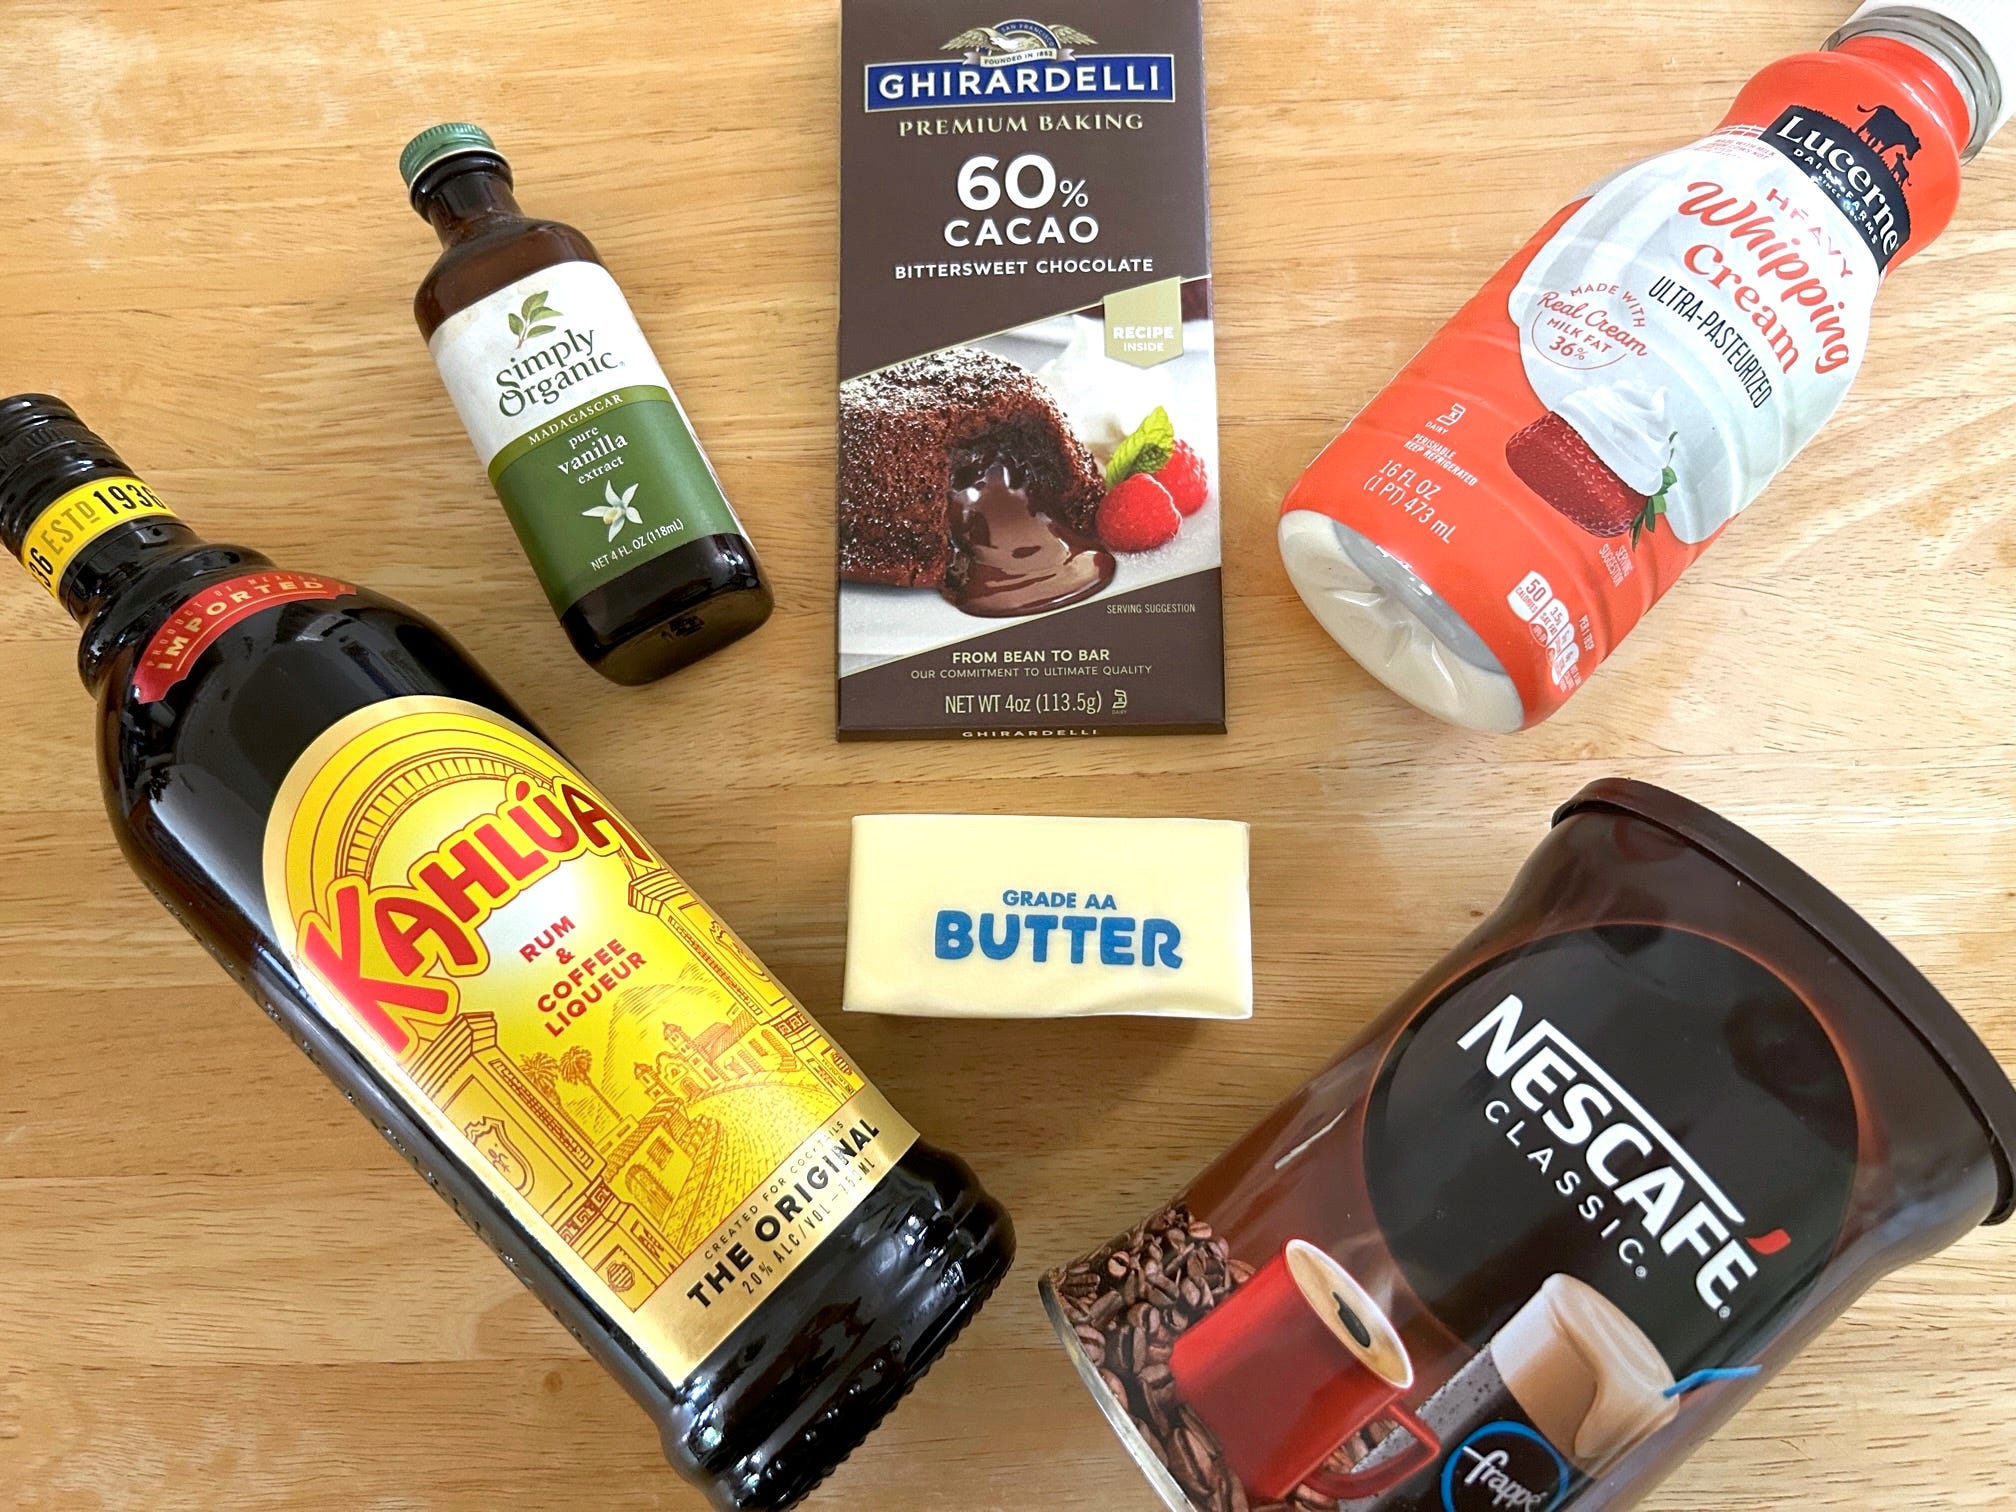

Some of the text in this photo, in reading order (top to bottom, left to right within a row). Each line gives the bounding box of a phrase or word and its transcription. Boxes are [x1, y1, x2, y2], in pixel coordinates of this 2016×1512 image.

[1001, 23, 1055, 46] SAN FRANCISCO
[984, 54, 1022, 65] FOUNDED
[1036, 50, 1053, 58] 1852
[879, 65, 1159, 99] GHIRARDELLI
[899, 113, 1144, 137] PREMIUM BAKING
[957, 154, 1089, 211] 60%
[1777, 115, 1899, 255] Lucerne
[944, 216, 1099, 247] CACAO
[1846, 191, 1878, 244] FARMS
[895, 258, 1153, 279] BITTERSWEET CHOCOLATE
[1678, 181, 1849, 375] Whipping
[1538, 291, 1648, 357] Real Cream
[1570, 283, 1646, 328] MADE WITH
[1684, 244, 1799, 374] Cream
[1113, 326, 1174, 339] RECIPE
[1123, 342, 1164, 352] INSIDE
[1547, 318, 1613, 354] MILK FAT
[1549, 335, 1585, 361] 36%
[1648, 275, 1773, 408] ULTRA-PASTEURIZED
[496, 328, 595, 394] Simply
[499, 352, 619, 417] Organic
[528, 394, 624, 446] MADAGASCAR
[568, 426, 599, 449] pure
[1425, 421, 1449, 434] DAIRY
[558, 434, 628, 474] vanilla
[1403, 440, 1478, 486] KEEP REFRIGERATED
[1412, 433, 1456, 460] PERISHABLE
[578, 456, 624, 484] extract
[1378, 460, 1441, 500] 16 FL OZ
[93, 484, 167, 514] 1936
[1363, 475, 1457, 544] (1 PT) 473 mL
[590, 518, 684, 571] NET 4 FL. OZ (118mL)
[1599, 543, 1625, 587] SUGGESTION
[1616, 545, 1633, 577] SERVING
[1106, 603, 1195, 615] SERVING SUGGESTION
[1515, 587, 1539, 613] CALORIES
[1526, 579, 1547, 602] 50
[157, 581, 324, 669] IMPORTED
[911, 665, 1152, 680] OUR COMMITMENT TO ULTIMATE QUALITY
[952, 649, 1110, 665] FROM BEAN TO BAR
[945, 690, 1102, 715] NET WT 4oz (113.5g)
[962, 728, 1098, 738] GHIRARDELLI
[301, 778, 657, 1055] KAHLÚA
[1002, 889, 1117, 910] GRADE AA
[519, 915, 576, 963] RUM
[556, 948, 576, 966] &
[934, 910, 1184, 969] BUTTER
[537, 938, 628, 1014] COFFEE
[544, 951, 648, 1038] LIQUEUR
[1457, 994, 1792, 1310] NESCAFÉ
[705, 1121, 844, 1260] CREATED FOR COCKTAILS
[1484, 1100, 1645, 1264] CLASSIC
[687, 1119, 880, 1308] THE ORIGINAL
[742, 1261, 773, 1294] 20%
[773, 1203, 831, 1264] ALC/VOL
[1463, 1445, 1548, 1512] frappé
